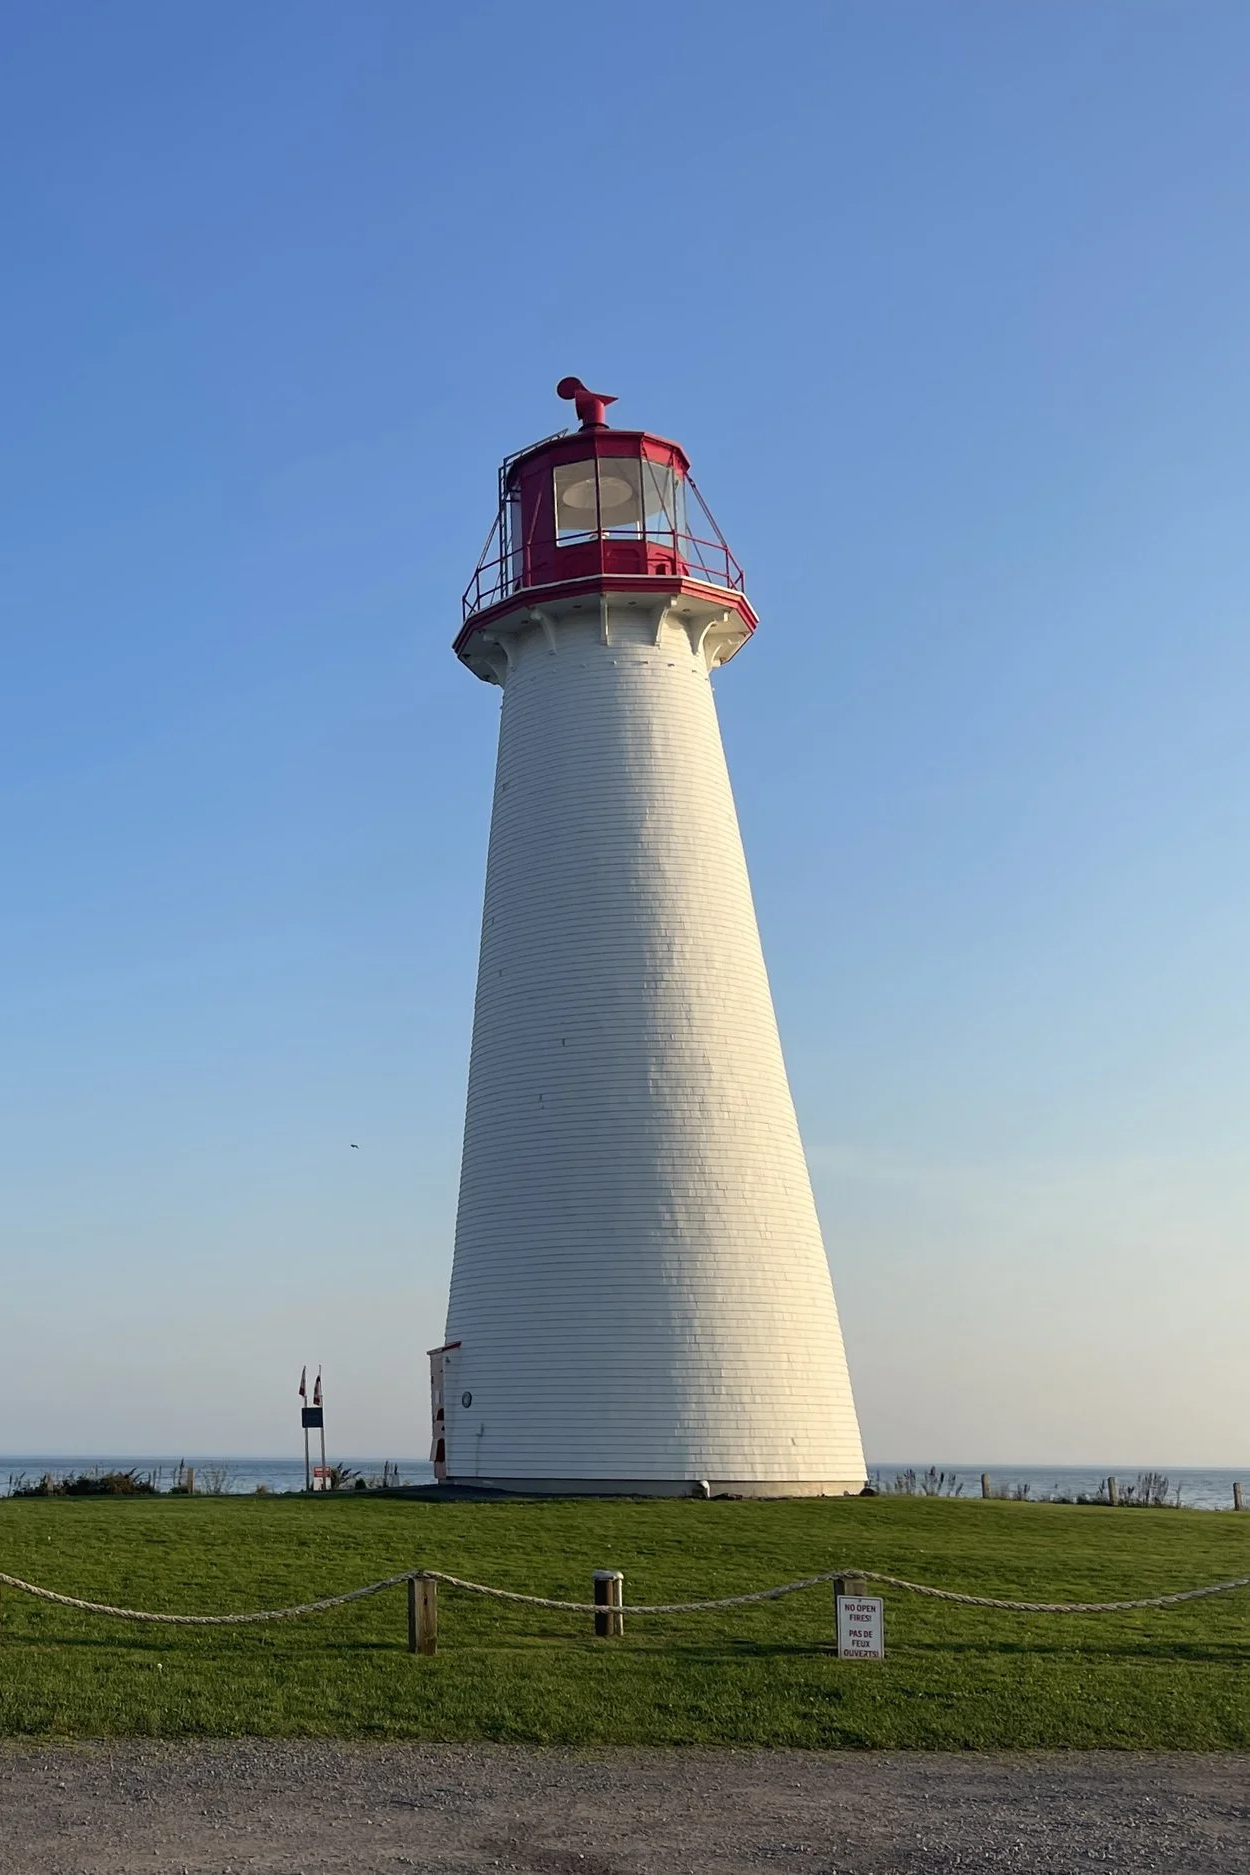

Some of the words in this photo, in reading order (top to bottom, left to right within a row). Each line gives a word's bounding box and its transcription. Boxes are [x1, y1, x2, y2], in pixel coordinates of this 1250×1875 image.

[857, 1604, 876, 1612] OPEN
[849, 1630, 862, 1638] PAS
[852, 1640, 870, 1648] FEUX
[843, 1649, 880, 1658] OUVERTS!
